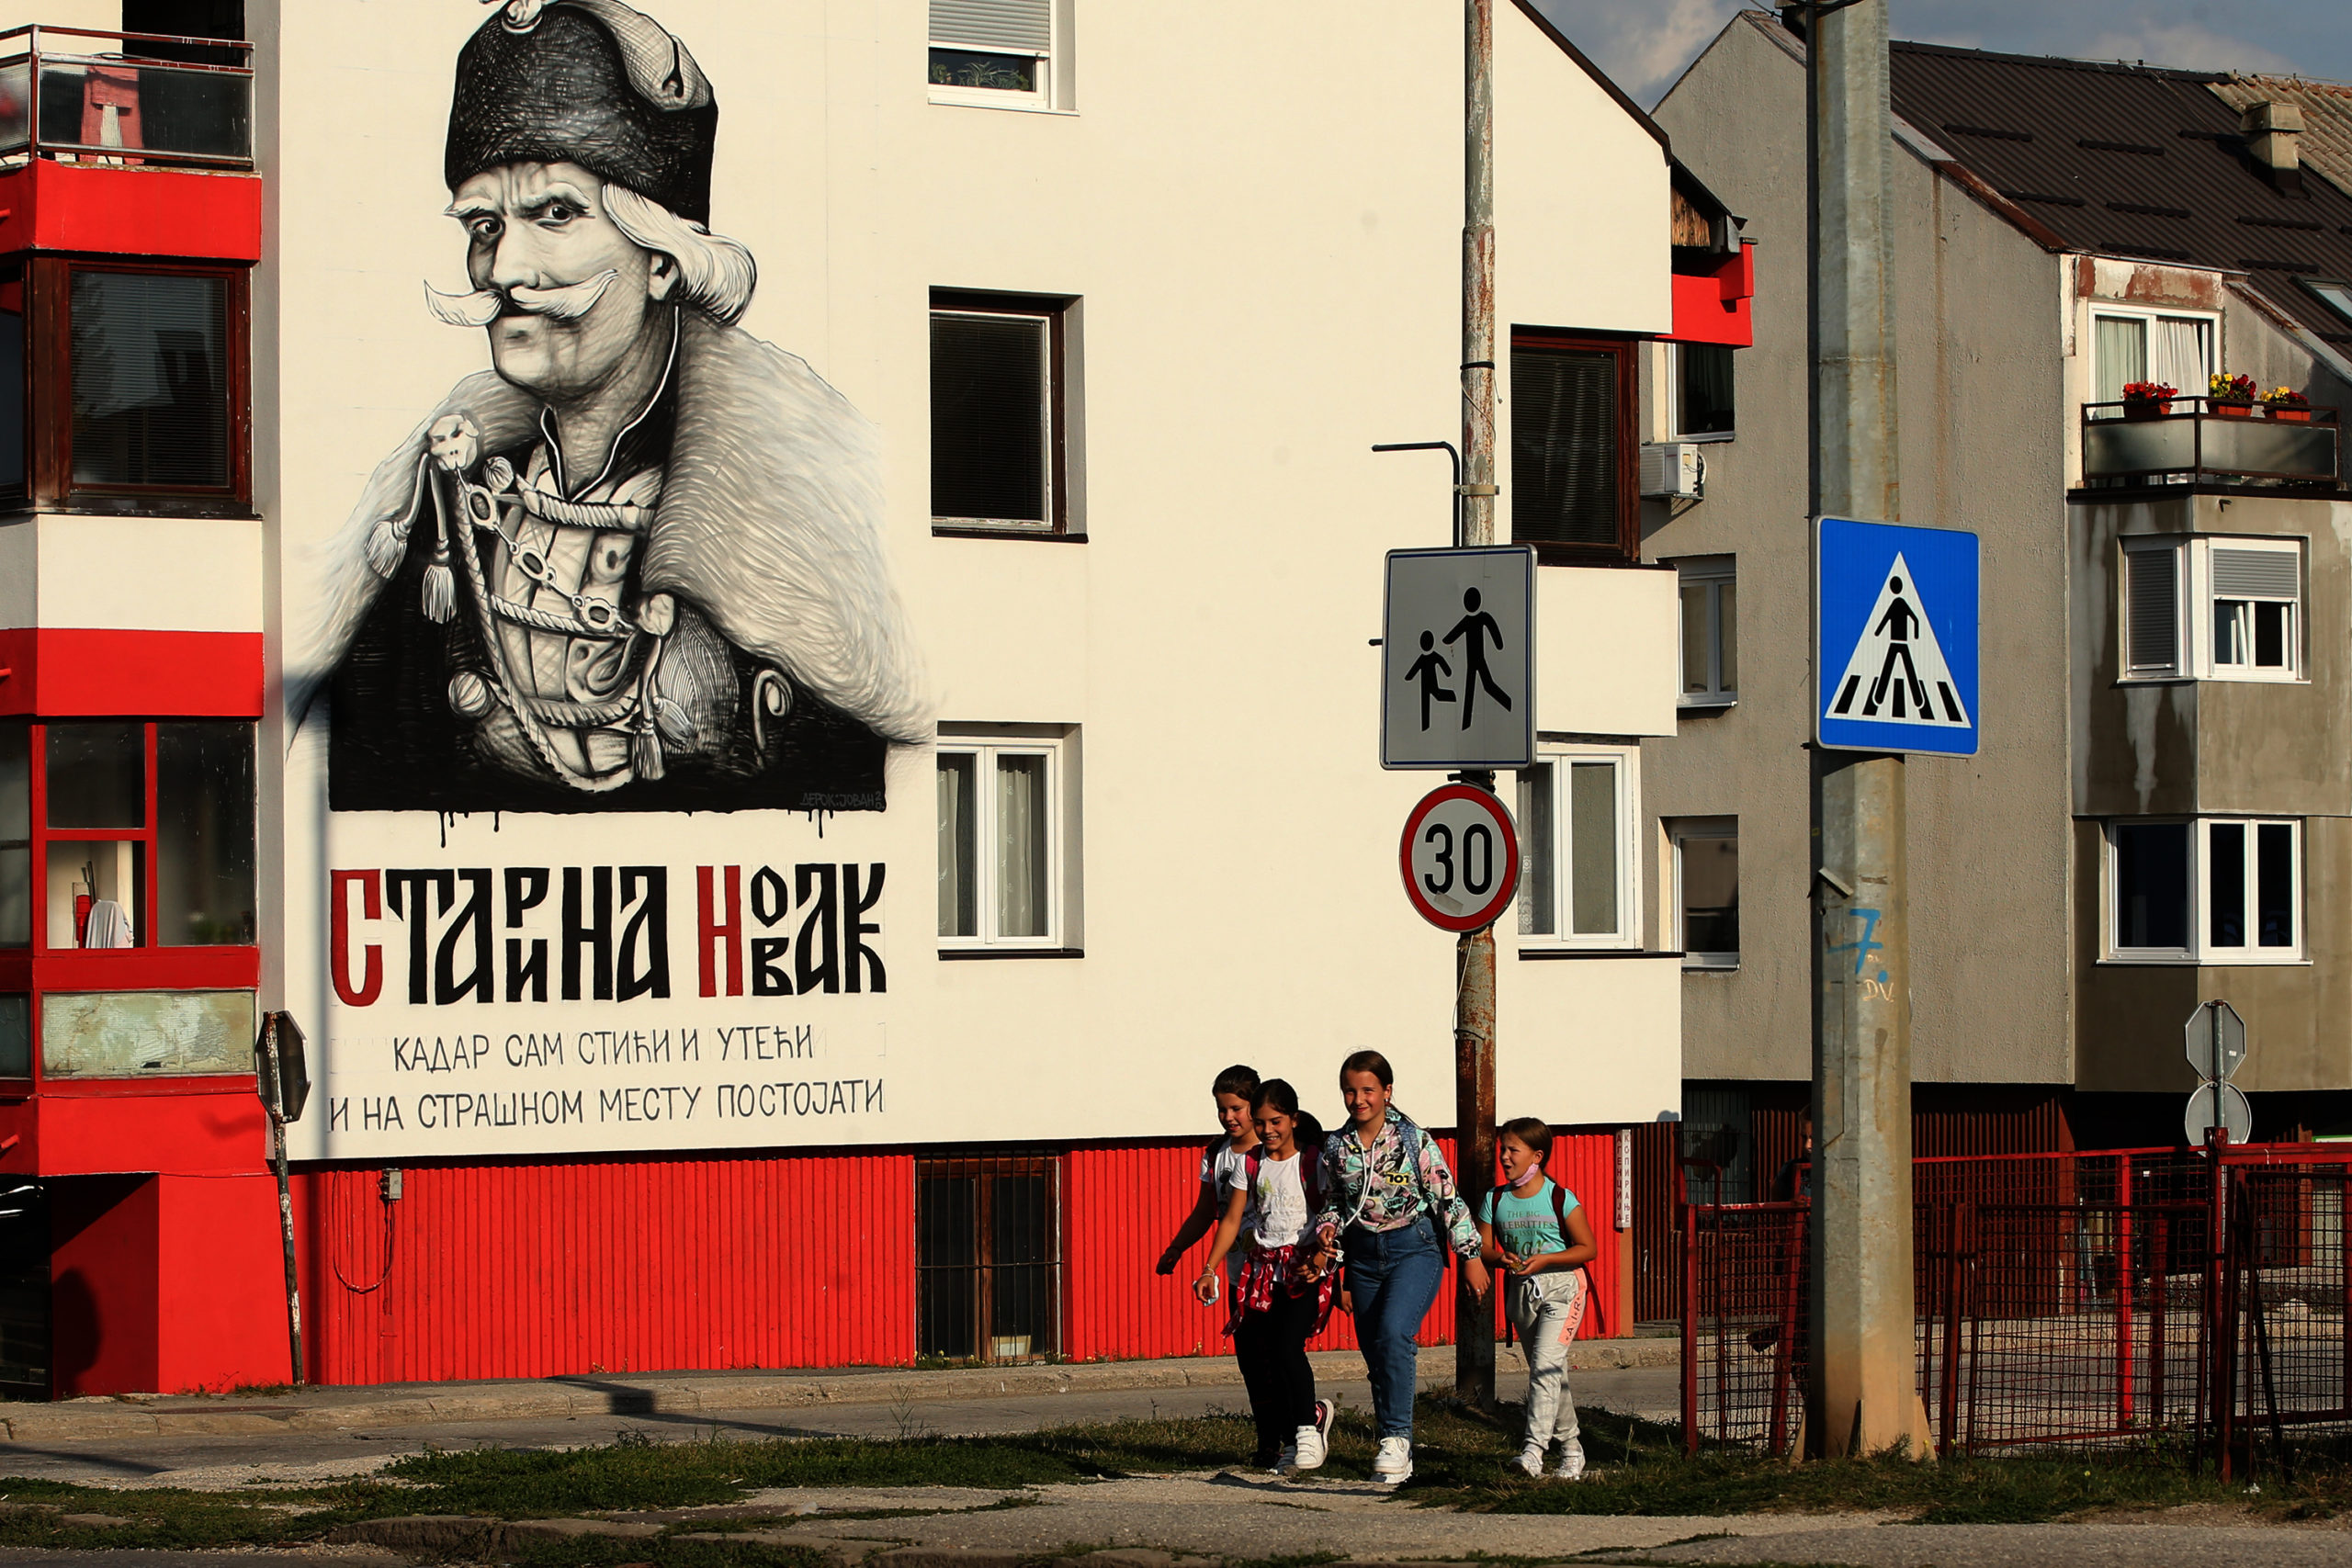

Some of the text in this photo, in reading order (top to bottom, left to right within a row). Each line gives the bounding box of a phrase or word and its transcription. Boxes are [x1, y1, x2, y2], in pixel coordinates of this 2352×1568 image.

[1424, 823, 1493, 896] 30
[395, 1026, 813, 1073] КАДАР САМ СТИЋИ И УТЕЋИ
[332, 1080, 883, 1132] И НА СТРАШНОМ МЕСТУ ПОСТОЈАТИ
[1497, 1220, 1555, 1230] LEBRITIES
[1507, 1210, 1541, 1218] THE BIG
